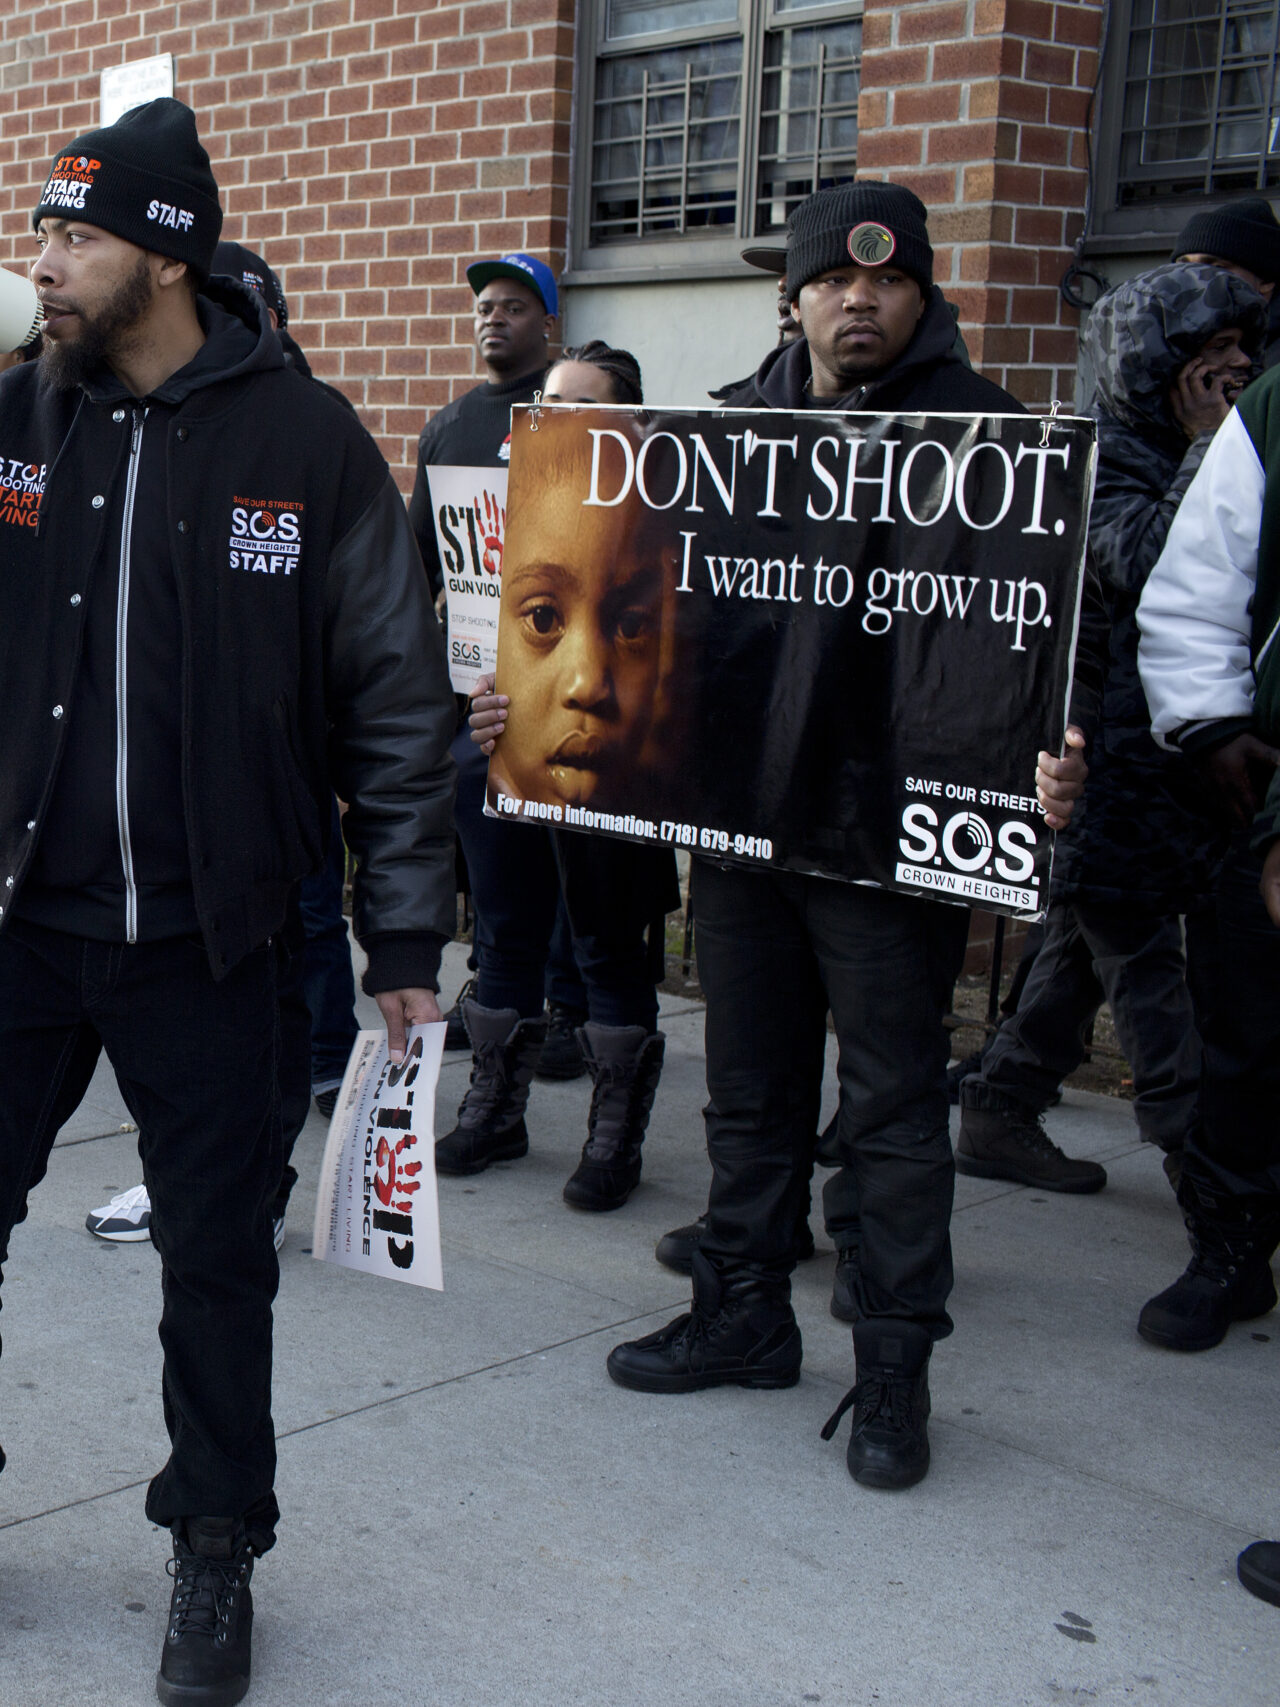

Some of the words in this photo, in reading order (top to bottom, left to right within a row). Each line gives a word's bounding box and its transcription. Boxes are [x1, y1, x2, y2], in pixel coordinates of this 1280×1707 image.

[50, 170, 95, 184] SHOOTING
[54, 156, 102, 174] STOP
[40, 193, 86, 209] LIVING
[45, 179, 92, 198] START
[146, 199, 195, 232] STAFF
[582, 427, 798, 517] DON'T
[806, 435, 1070, 537] SHOOT.
[233, 495, 250, 506] SAVE
[250, 499, 266, 508] OUR
[267, 500, 305, 511] STREETS
[231, 507, 302, 542] S.O.S.
[232, 538, 258, 549] CROWN
[259, 542, 297, 553] HEIGHTS
[229, 550, 299, 575] STAFF
[449, 578, 474, 595] GUN
[675, 531, 698, 593] I
[704, 553, 805, 602] want
[812, 555, 854, 608] to
[861, 567, 980, 635] grow
[989, 576, 1053, 652] up.
[452, 614, 467, 624] STOP
[904, 776, 942, 796] SAVE
[945, 783, 977, 803] OUR
[979, 789, 1048, 815] STREETS
[497, 793, 522, 815] For
[524, 800, 562, 822] more
[565, 804, 658, 839] information:
[660, 820, 697, 846] (718)
[700, 827, 773, 860] 679-9410
[899, 803, 1040, 886] S.O.S.
[902, 868, 956, 889] CROWN
[963, 880, 1031, 905] HEIGHTS
[373, 1060, 393, 1100] UN
[362, 1105, 378, 1256] VIOLENCE
